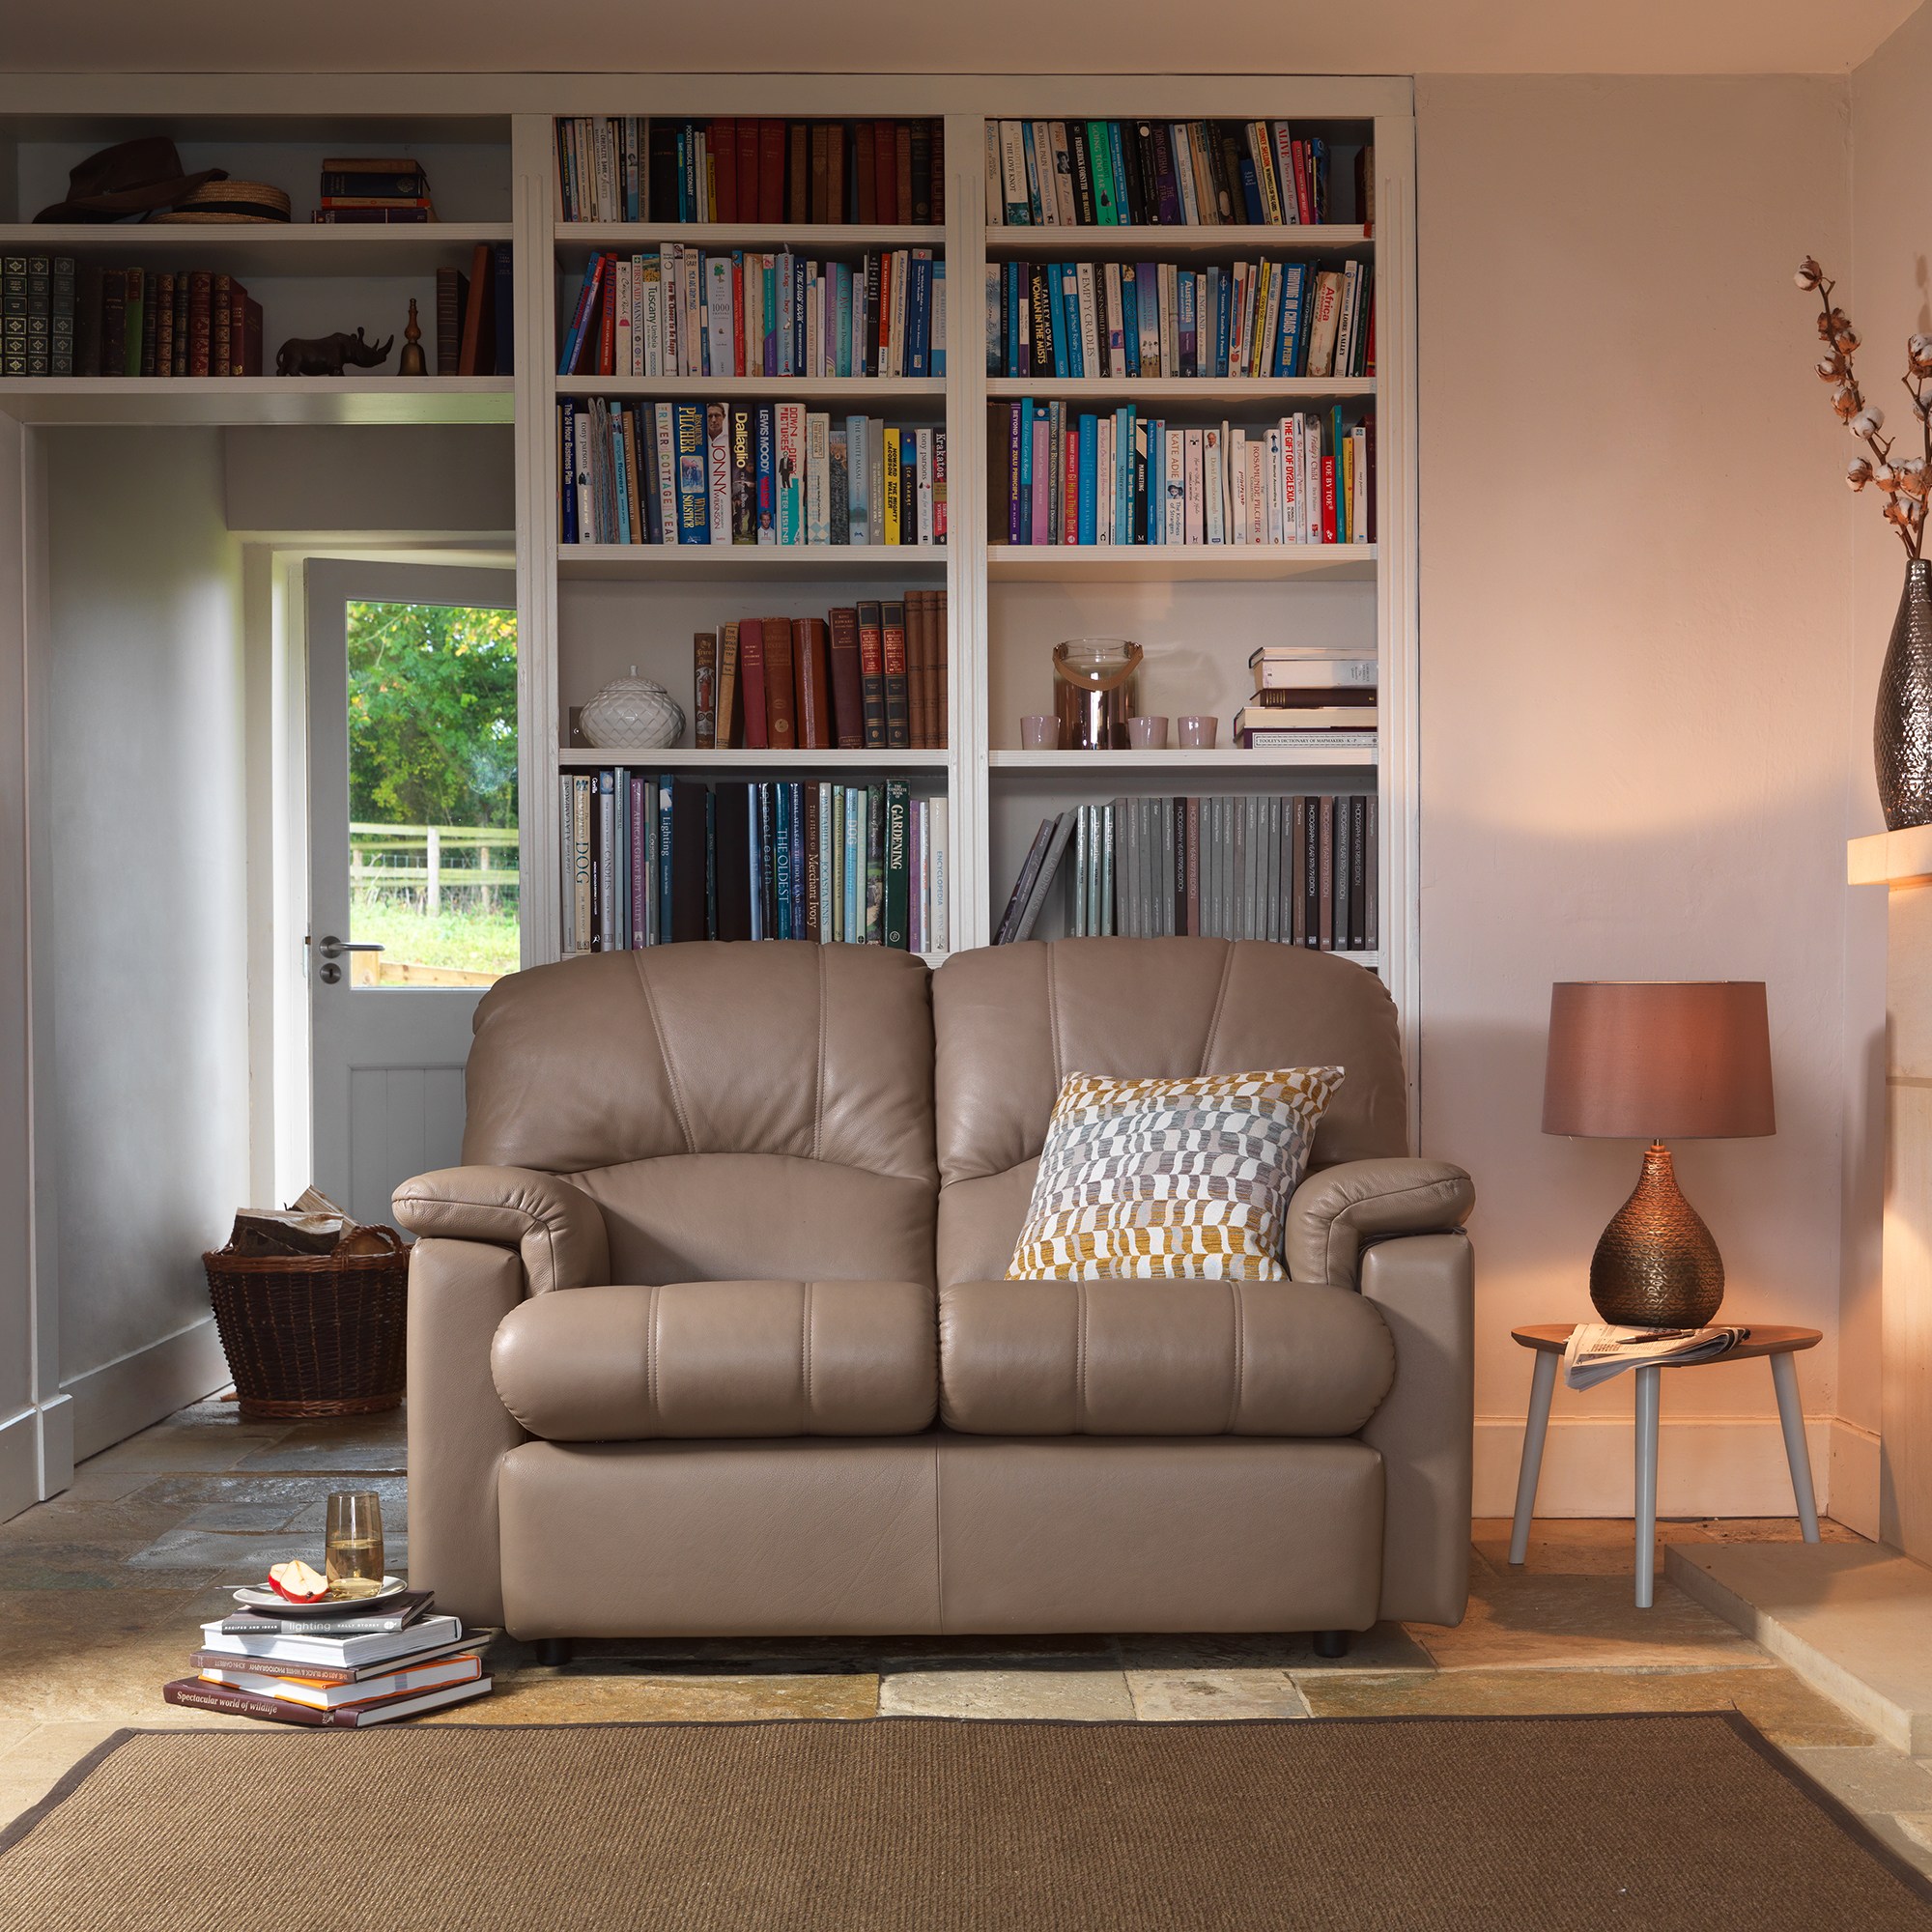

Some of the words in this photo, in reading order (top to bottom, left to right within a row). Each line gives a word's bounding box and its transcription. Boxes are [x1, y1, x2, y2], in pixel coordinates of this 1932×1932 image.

[1075, 137, 1084, 166] FREDERICK
[1092, 125, 1101, 152] GOING
[1153, 128, 1164, 146] JOHN
[1278, 128, 1290, 158] ALIVE
[1156, 147, 1168, 176] GRISHAM
[1078, 166, 1088, 189] FORSYTH
[1032, 275, 1041, 314] WOMAN
[1082, 277, 1092, 312] EMPTY
[1287, 268, 1301, 298] THRIVING
[647, 287, 657, 325] Tuscany
[1184, 280, 1193, 323] Australia
[1285, 299, 1297, 309] ON
[1317, 296, 1325, 323] shoestring
[1322, 287, 1335, 322] Africa
[1035, 314, 1042, 323] IN
[1036, 324, 1044, 340] THE
[1283, 311, 1296, 334] CHAOS
[1085, 313, 1094, 357] CRADLES
[1284, 336, 1293, 346] TOM
[1339, 333, 1348, 355] VALLEY
[1037, 340, 1046, 364] MISTS
[1282, 348, 1293, 365] PETERS
[565, 416, 572, 425] 24
[580, 421, 588, 440] tony
[659, 412, 668, 444] RIVER
[679, 407, 696, 453] PILCHER
[760, 410, 769, 436] LEWIS
[781, 407, 789, 451] PICTURES
[580, 440, 589, 469] parsons
[734, 412, 748, 469] Dallaglio
[760, 437, 769, 473] MOODY
[711, 443, 726, 495] JONNY
[788, 448, 797, 475] DIRTY
[920, 452, 928, 480] parsons
[936, 433, 946, 478] Krakatoa
[1286, 454, 1293, 465] OF
[661, 454, 671, 504] COTTAGE
[1065, 483, 1076, 494] Hip
[1286, 467, 1294, 502] DYSLEXIA
[1325, 478, 1332, 489] BY
[682, 495, 694, 528] SOLSTICE
[695, 497, 705, 526] WINTER
[1065, 499, 1076, 518] Thigh
[665, 514, 674, 543] YEAR
[1067, 519, 1076, 533] Diet
[661, 816, 671, 856] Lighting
[778, 828, 788, 852] THE
[892, 804, 903, 869] GARDENING
[576, 842, 589, 883] DOG
[764, 845, 773, 885] earth
[809, 854, 818, 899] Merchant
[779, 855, 788, 903] OLDEST
[1032, 858, 1057, 910] LANDMARKS
[807, 902, 819, 927] Ivory
[289, 1621, 331, 1633] lighting
[214, 1660, 233, 1668] GARRETT
[249, 1663, 285, 1673] PHOTOGRAPHY
[177, 1690, 218, 1706] Spectacular
[219, 1698, 241, 1708] world
[242, 1700, 249, 1711] of
[249, 1701, 278, 1716] wildlife
